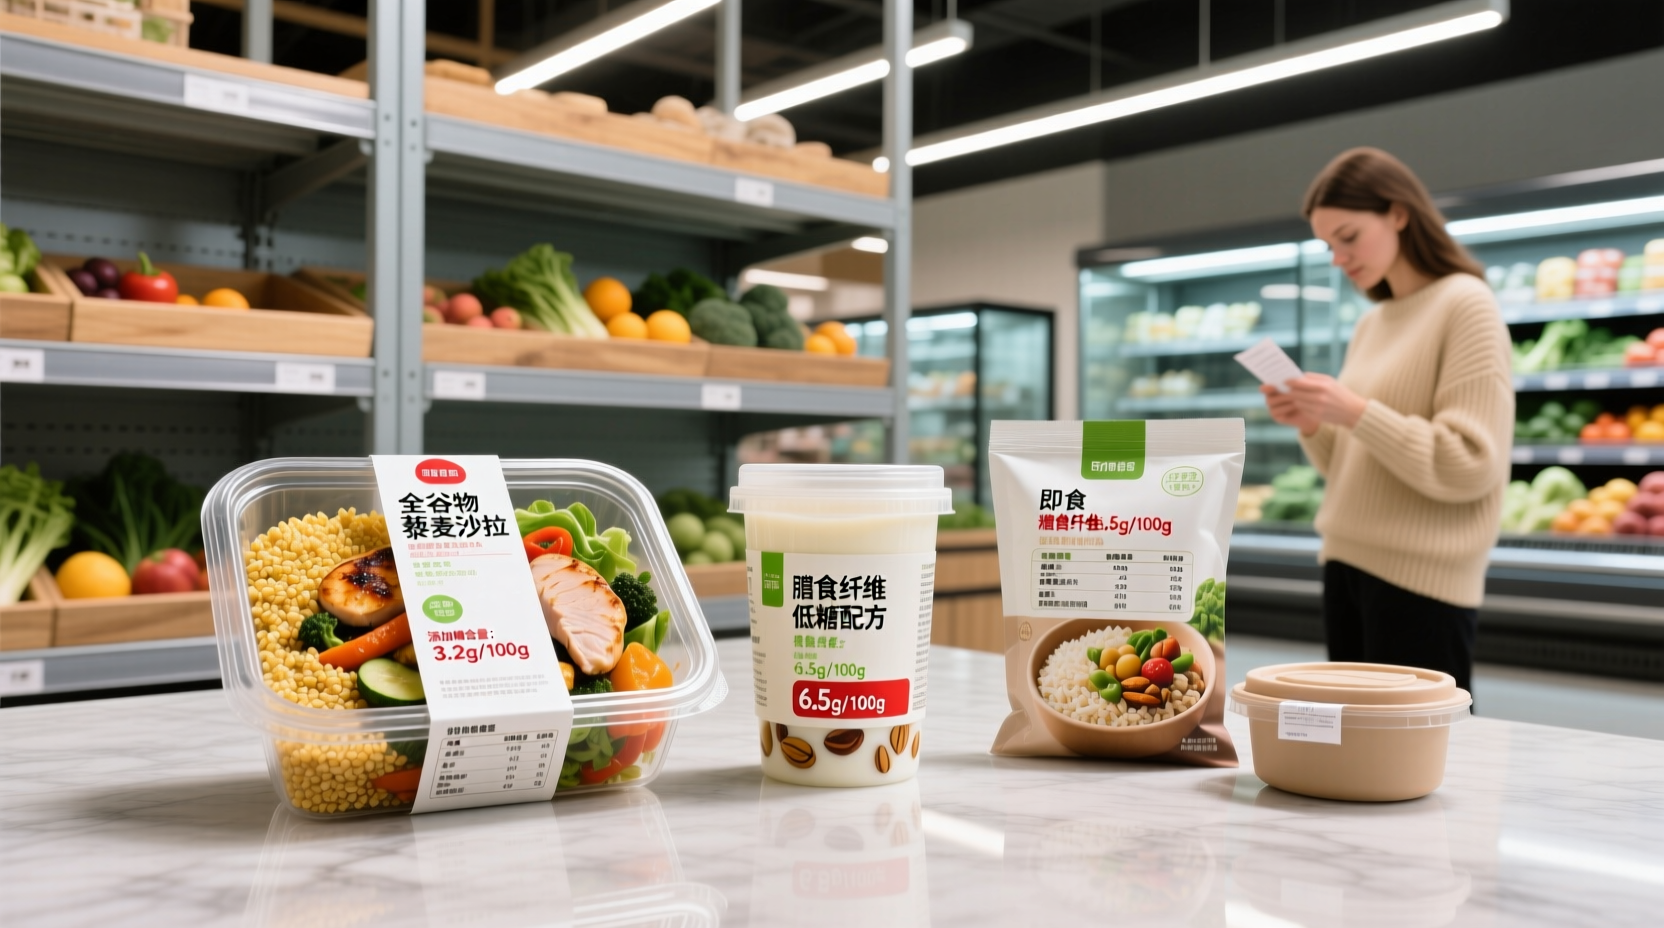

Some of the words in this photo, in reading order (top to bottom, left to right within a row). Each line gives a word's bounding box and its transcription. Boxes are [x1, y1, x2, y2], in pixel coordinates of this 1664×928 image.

[398, 492, 479, 514] 全谷物
[1039, 488, 1087, 511] 即食
[400, 514, 510, 540] 藜麦沙拉
[792, 604, 887, 630] 低糖配方
[433, 642, 530, 663] 3.2g/100g
[794, 662, 866, 680] 6.5g/100g
[798, 687, 886, 716] 6.5g/100g
